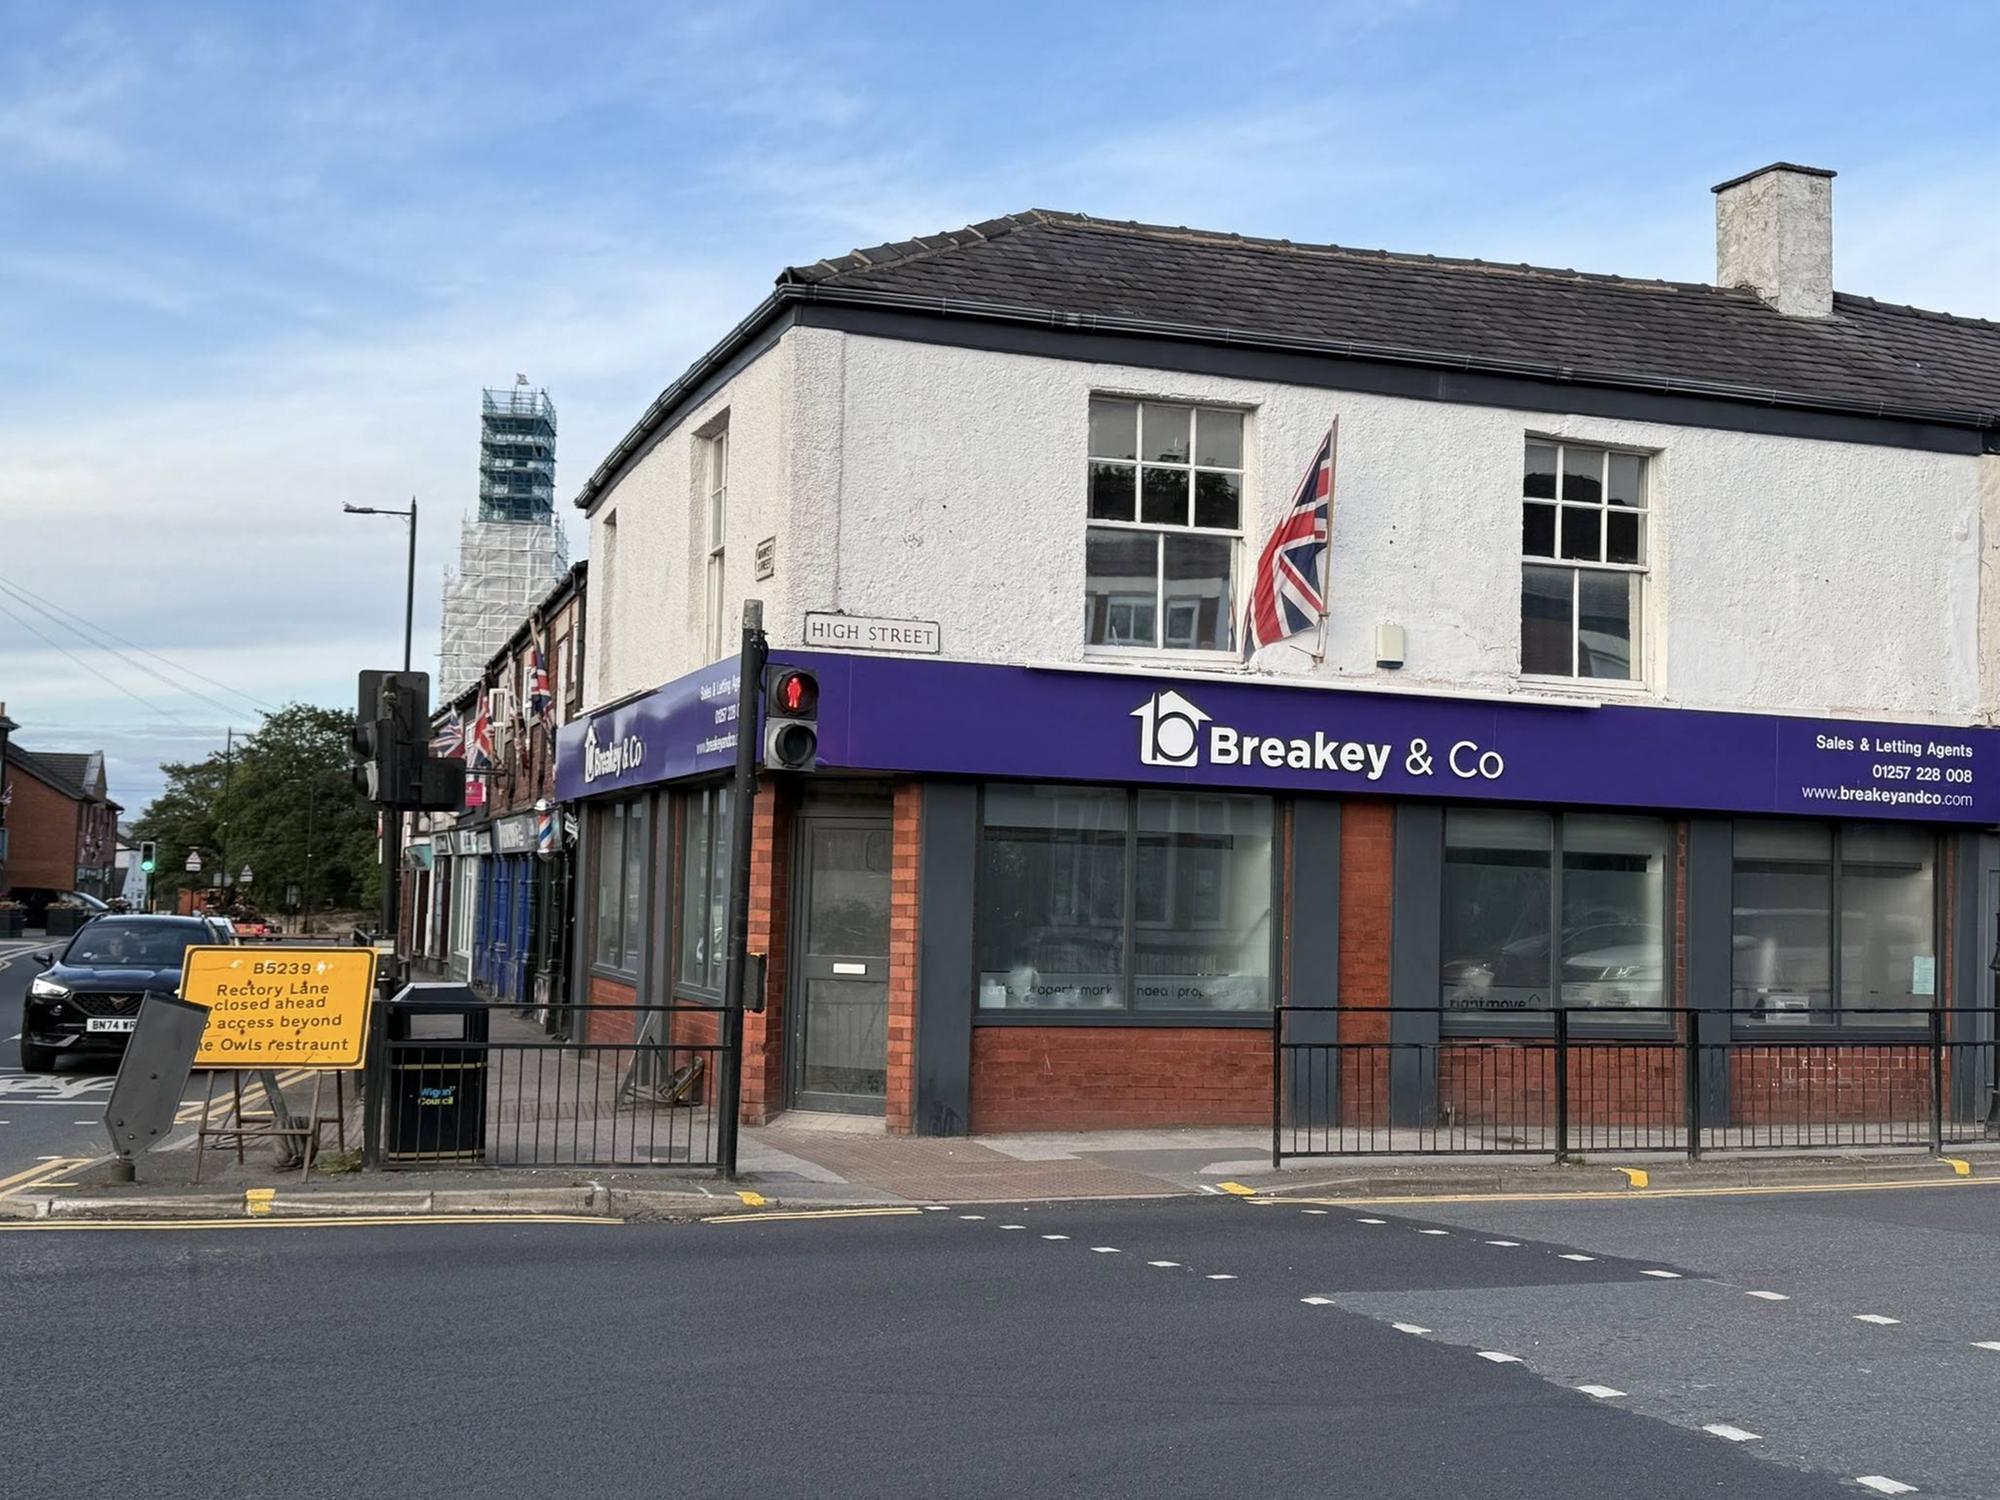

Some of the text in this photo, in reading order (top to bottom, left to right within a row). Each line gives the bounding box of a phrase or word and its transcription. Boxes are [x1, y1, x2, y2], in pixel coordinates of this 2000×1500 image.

[811, 621, 933, 645] HIGH STREET
[1210, 726, 1504, 781] Breakey & Co
[1816, 734, 1973, 759] Sales & Letting Agents
[595, 735, 642, 778] Breakey & Co
[1872, 764, 1973, 783] 01257 228 008
[1802, 785, 1973, 807] www.breakeyandco.com
[253, 962, 312, 975] B5239
[217, 983, 330, 998] Rectory Lane
[1136, 987, 1168, 997] naea
[214, 996, 326, 1012] closed ahead
[217, 1017, 274, 1030] access
[280, 1014, 342, 1030] beyond
[220, 1038, 262, 1051] Owls
[267, 1039, 349, 1051] restraunt
